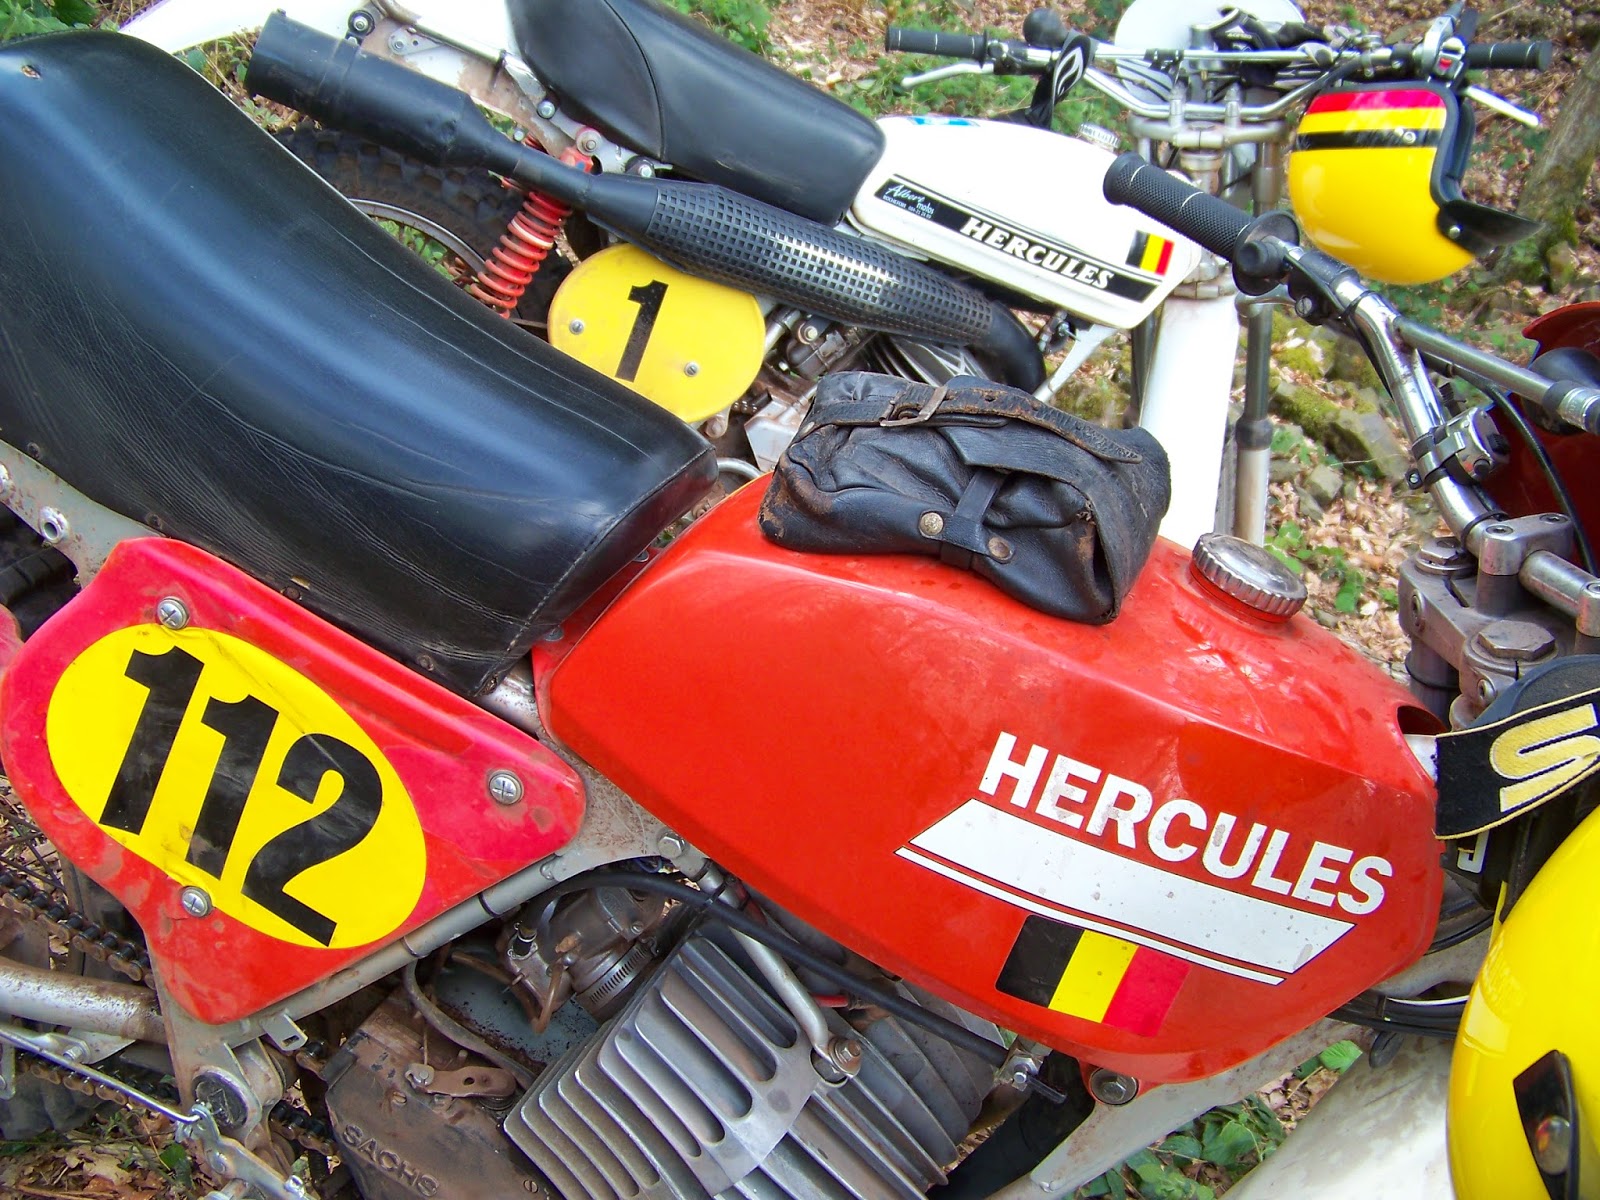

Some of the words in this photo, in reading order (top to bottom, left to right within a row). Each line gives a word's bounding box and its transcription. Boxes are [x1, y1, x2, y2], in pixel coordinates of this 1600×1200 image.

[885, 184, 925, 203] Albert
[916, 202, 934, 215] motos
[959, 215, 1115, 290] HERCULES
[614, 279, 669, 383] 1
[98, 645, 383, 948] 112
[978, 731, 1393, 915] HERCULES
[342, 1123, 440, 1197] SACHS
